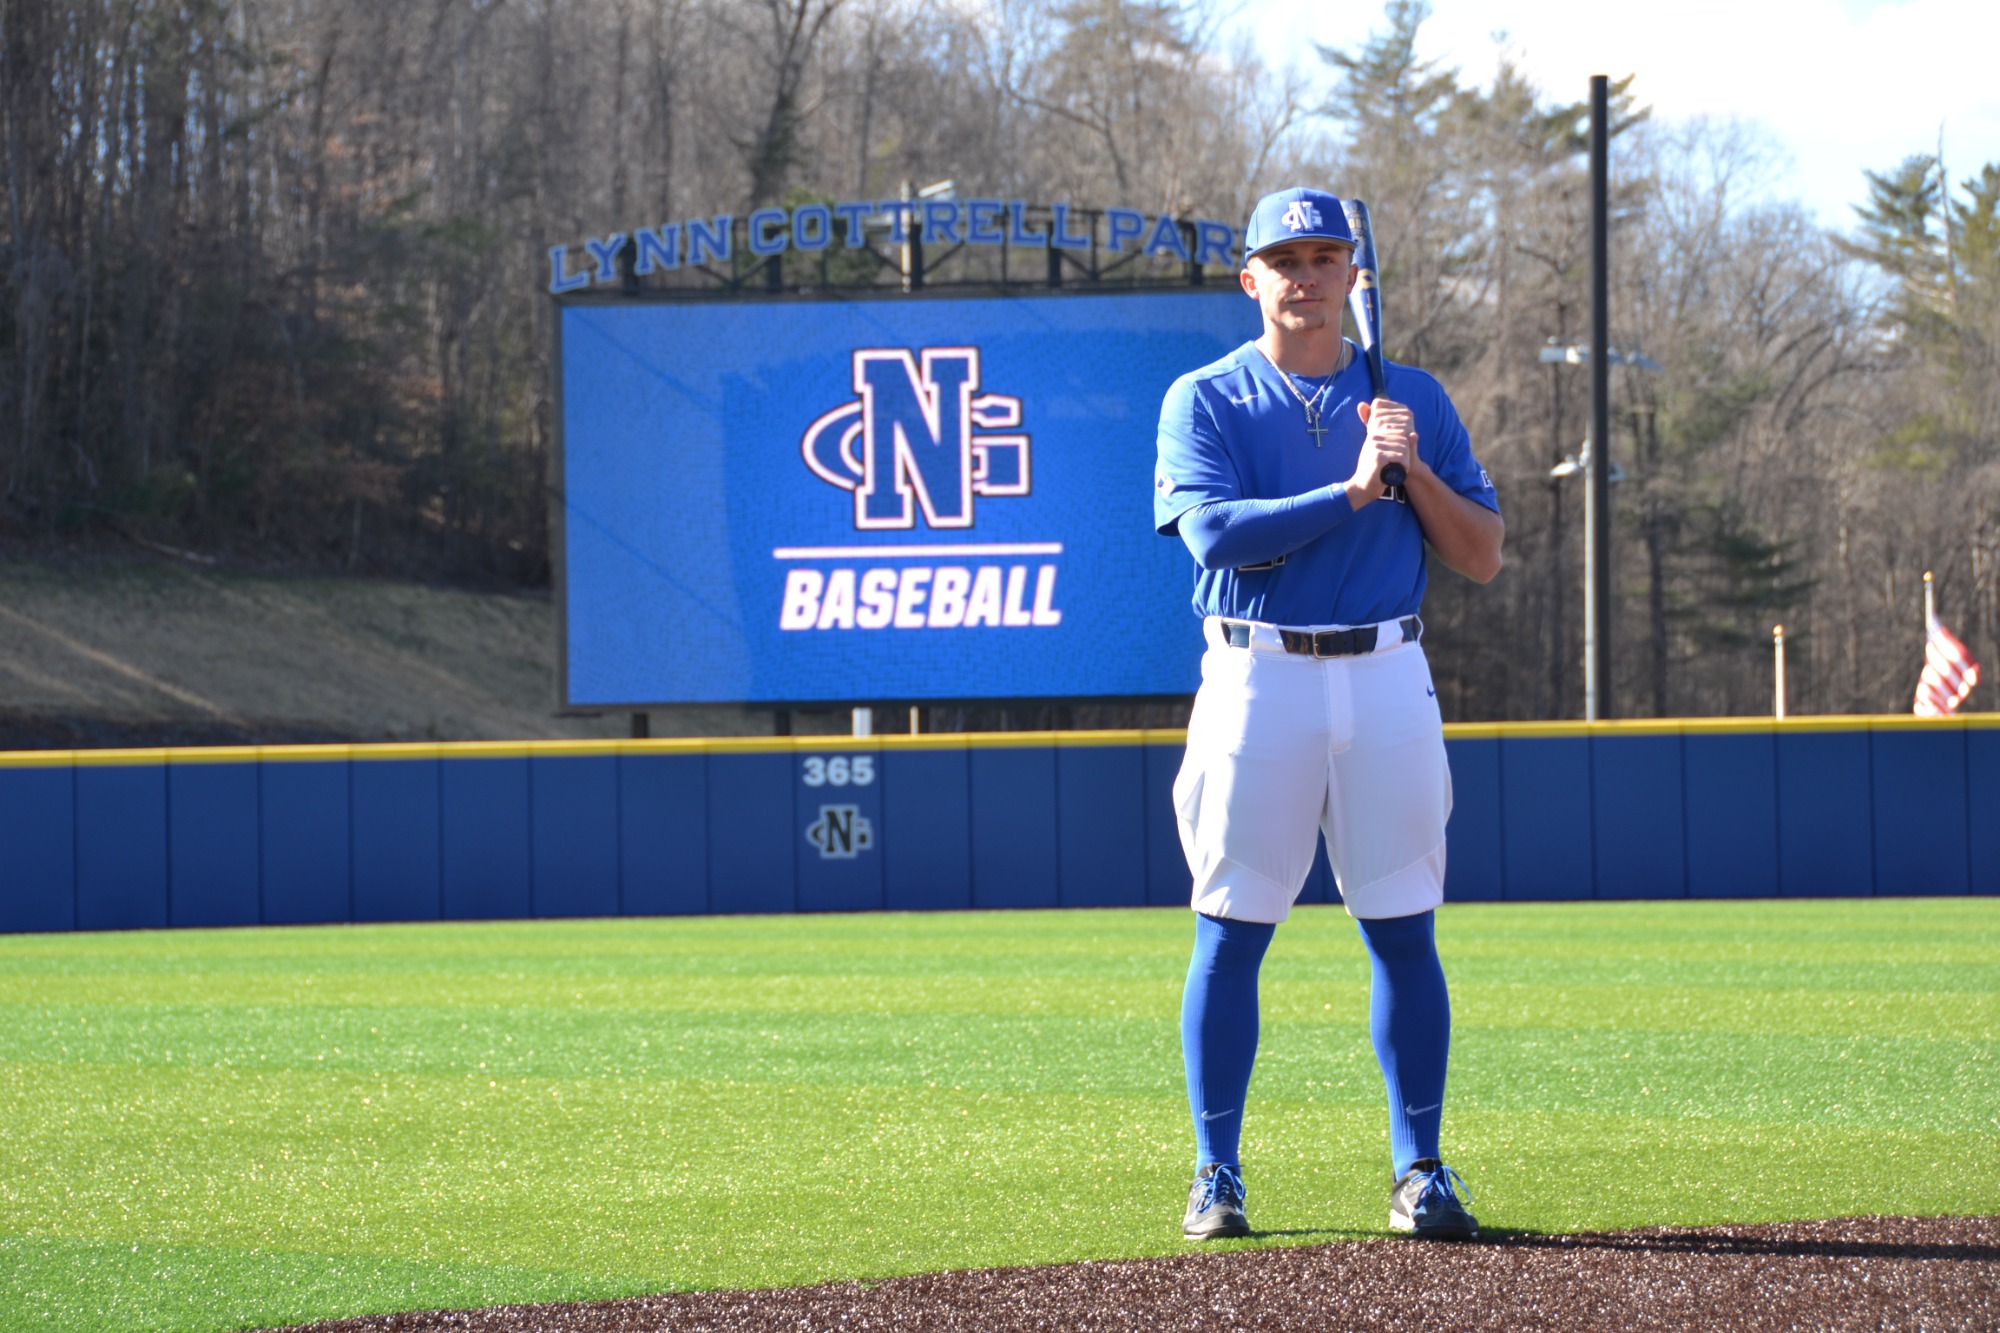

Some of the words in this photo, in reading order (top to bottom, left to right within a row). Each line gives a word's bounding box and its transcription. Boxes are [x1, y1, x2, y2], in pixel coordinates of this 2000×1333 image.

[549, 214, 735, 294] LYNN
[749, 200, 1091, 255] COTTRELL
[1104, 207, 1250, 267] PAR
[780, 565, 1062, 630] BASEBALL
[802, 755, 875, 787] 365
